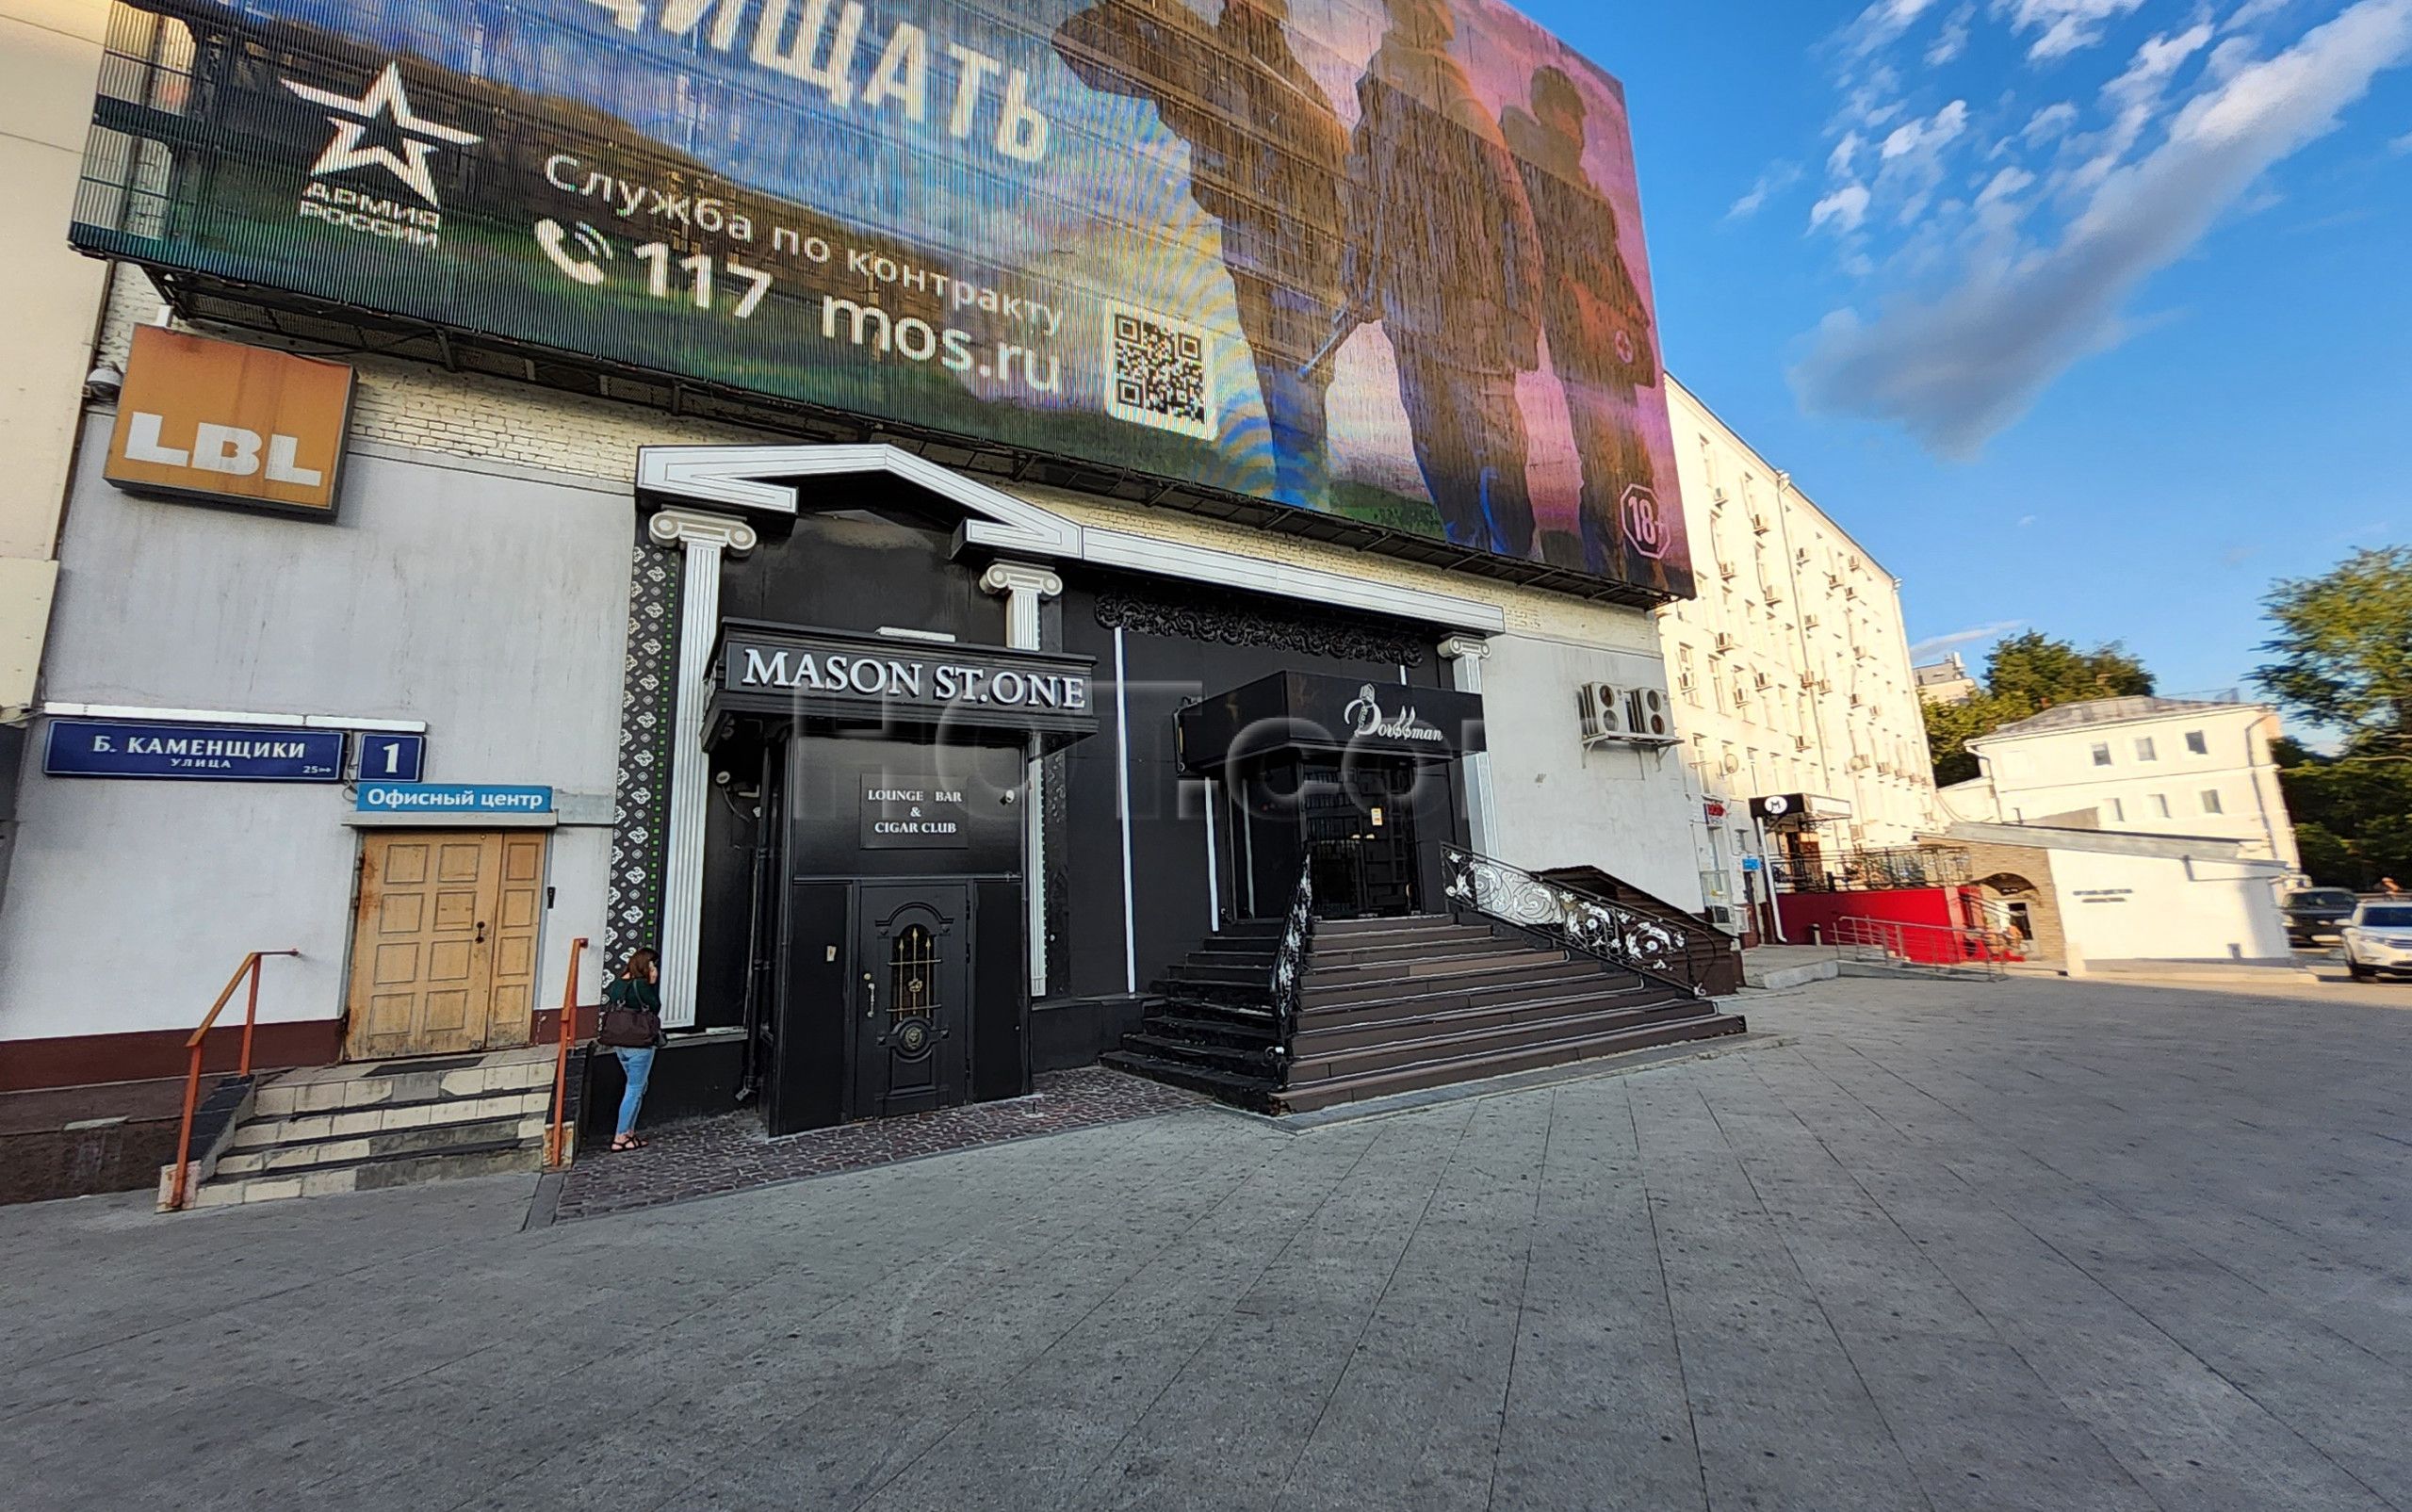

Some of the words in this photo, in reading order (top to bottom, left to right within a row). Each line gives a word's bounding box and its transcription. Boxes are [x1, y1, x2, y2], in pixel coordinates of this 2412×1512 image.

[546, 154, 752, 242] Служба
[774, 226, 831, 264] по
[847, 248, 1063, 337] контракту
[634, 241, 773, 319] 117
[822, 295, 1059, 394] mos.ru
[124, 413, 321, 487] LBL
[742, 648, 922, 696] MASON
[936, 665, 1085, 708] ST.ONE
[93, 735, 117, 753] Б.
[127, 737, 305, 759] КАМЕНЩИКИ
[383, 742, 400, 773] 1
[171, 757, 231, 769] УЛИЦА
[302, 765, 318, 773] 25
[367, 788, 474, 808] Офисный
[481, 794, 543, 810] центр
[868, 789, 923, 801] LOUNGE
[935, 791, 962, 802] BAR
[910, 806, 921, 817] &
[874, 822, 919, 833] CIGAR
[921, 822, 956, 833] CLUB
